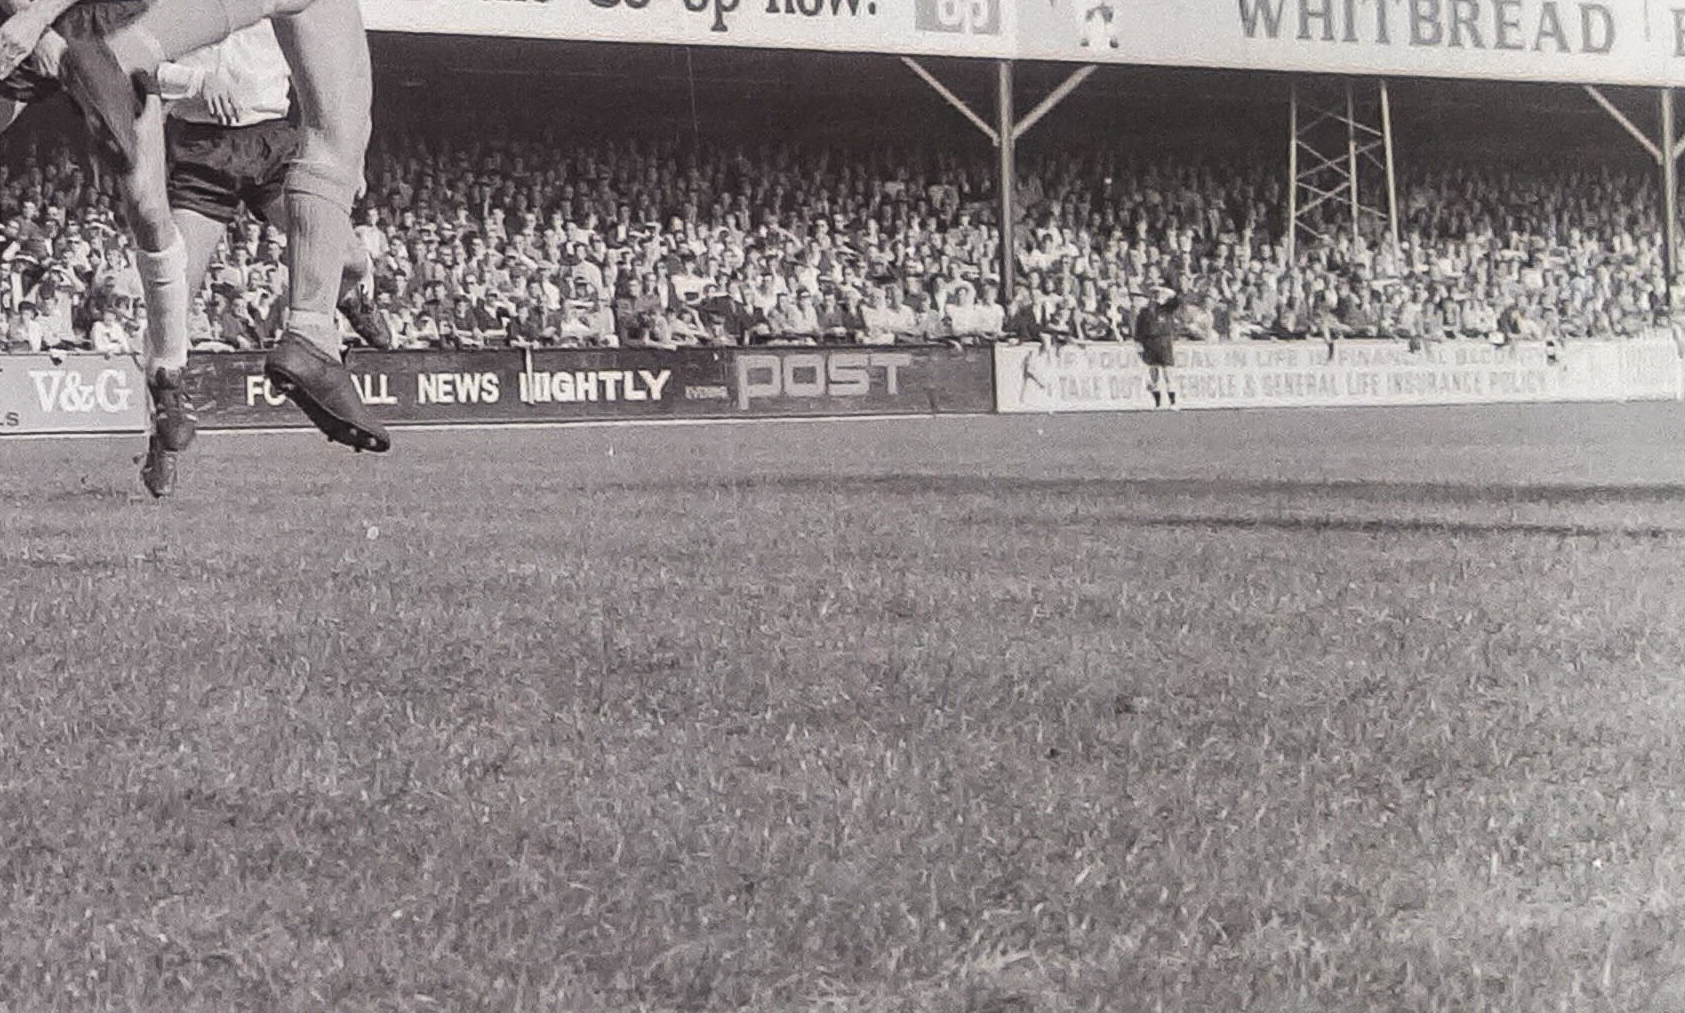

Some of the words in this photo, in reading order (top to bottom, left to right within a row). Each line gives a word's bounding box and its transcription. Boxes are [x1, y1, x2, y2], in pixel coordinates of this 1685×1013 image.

[28, 370, 136, 413] V&G
[417, 371, 500, 405] NEWS
[519, 369, 671, 404] NIGHTLY
[736, 353, 911, 410] POST
[1060, 376, 1102, 400] TAKE
[1178, 374, 1236, 399] EHICLE
[1264, 372, 1337, 397] GENERAL
[1347, 371, 1380, 396] LIFE
[1388, 370, 1482, 395] INSURANCE
[1490, 370, 1546, 395] POLICY
